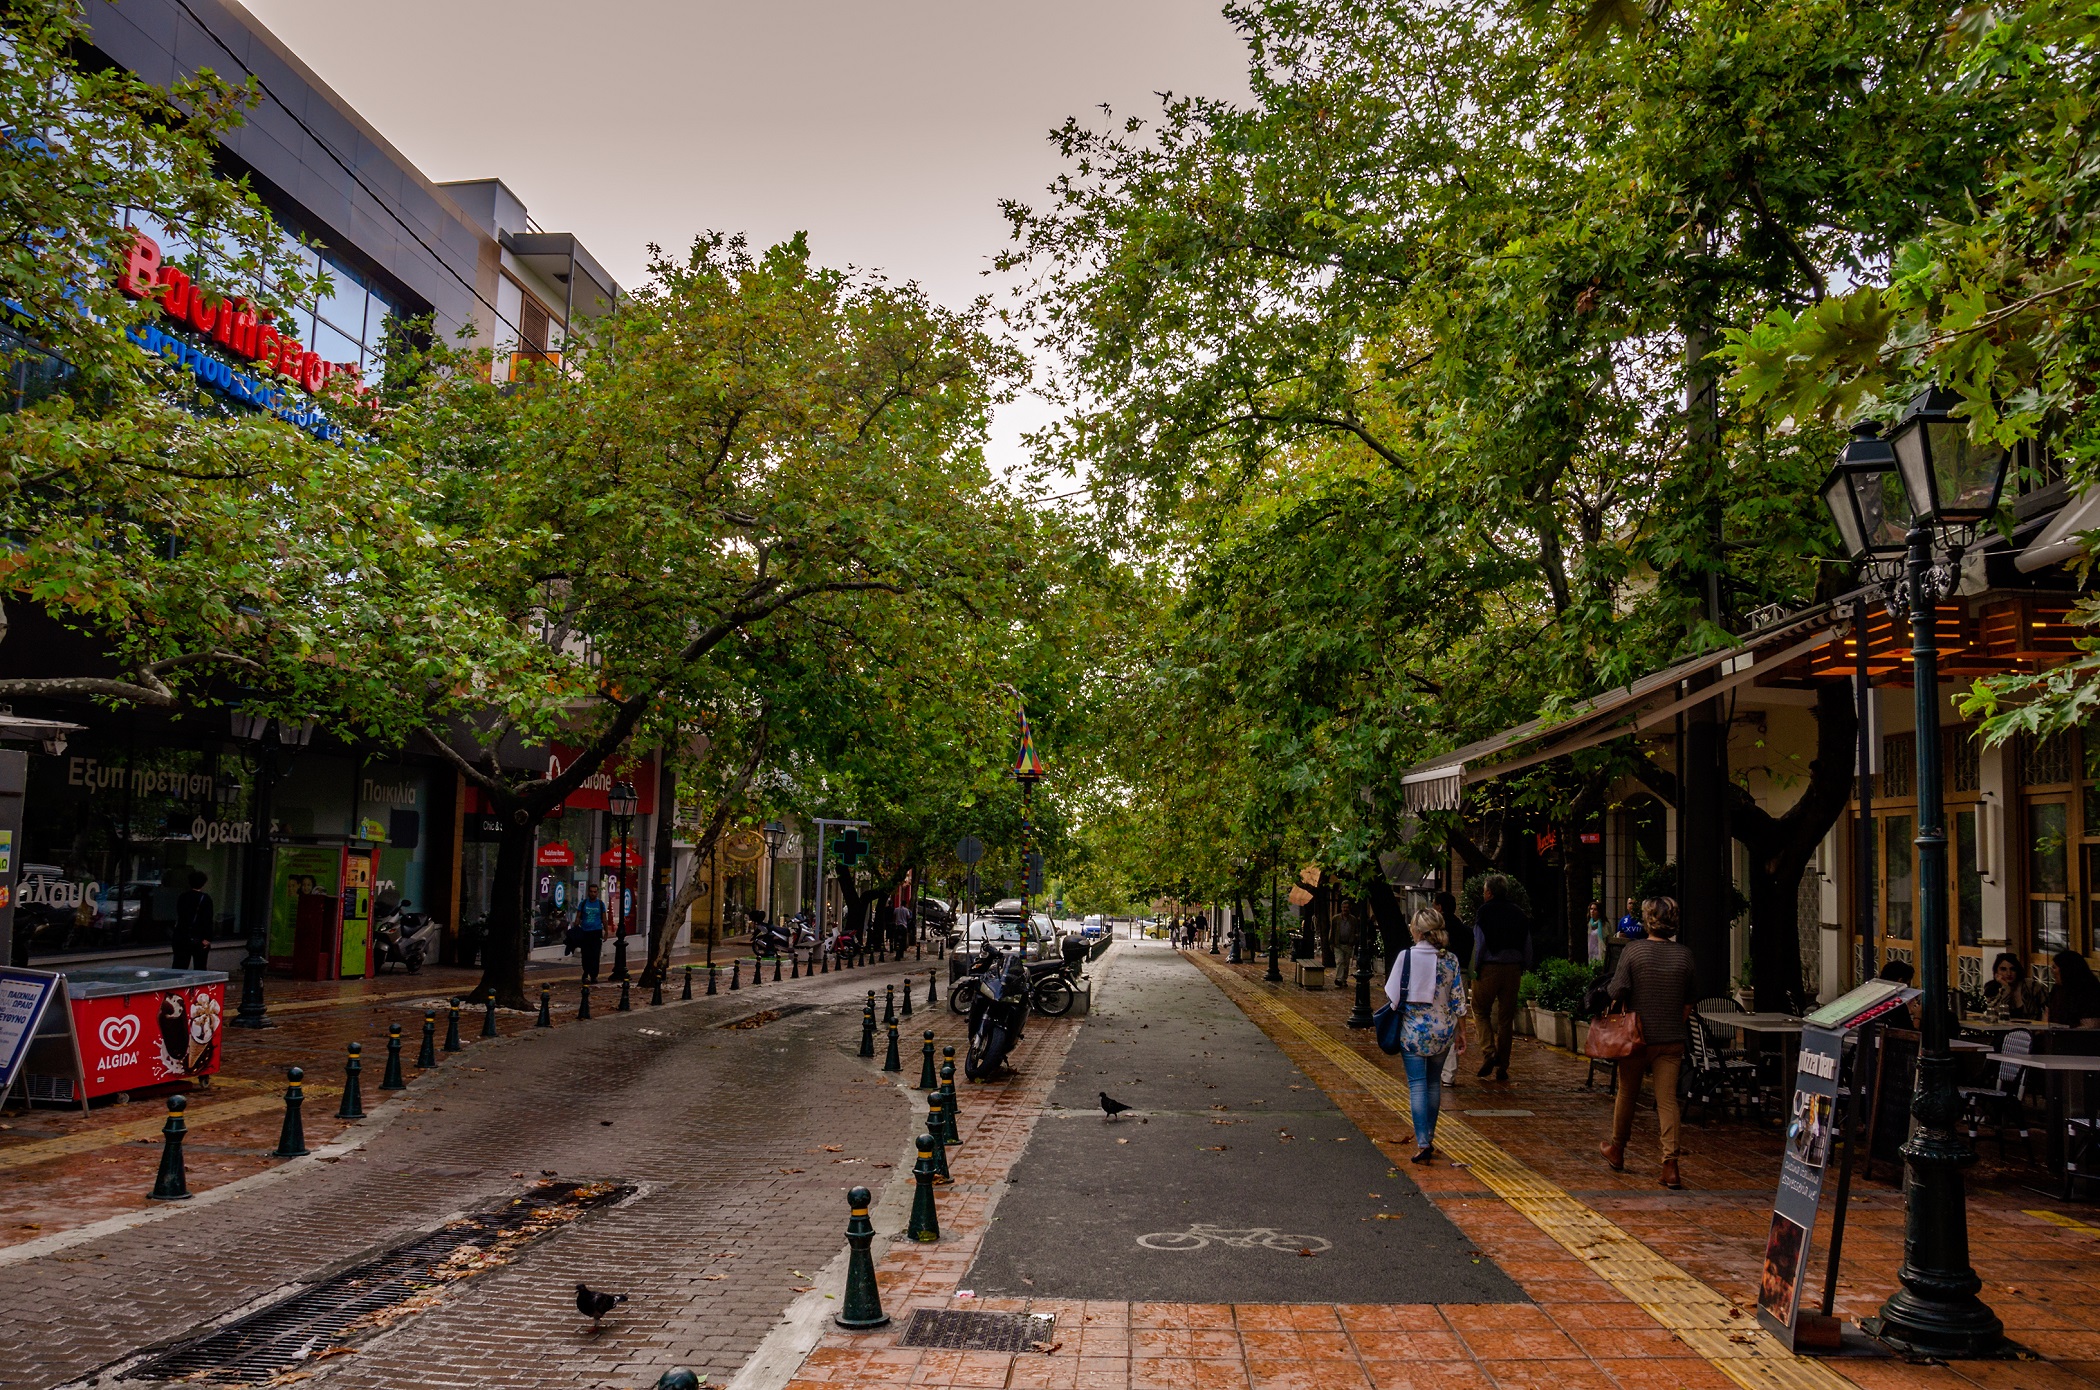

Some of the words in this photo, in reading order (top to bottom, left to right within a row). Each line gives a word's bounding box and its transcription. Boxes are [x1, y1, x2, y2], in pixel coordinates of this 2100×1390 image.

[362, 778, 416, 804] Ποικιλία
[97, 1051, 138, 1071] ALGIDA
[1797, 1048, 1820, 1075] pizza
